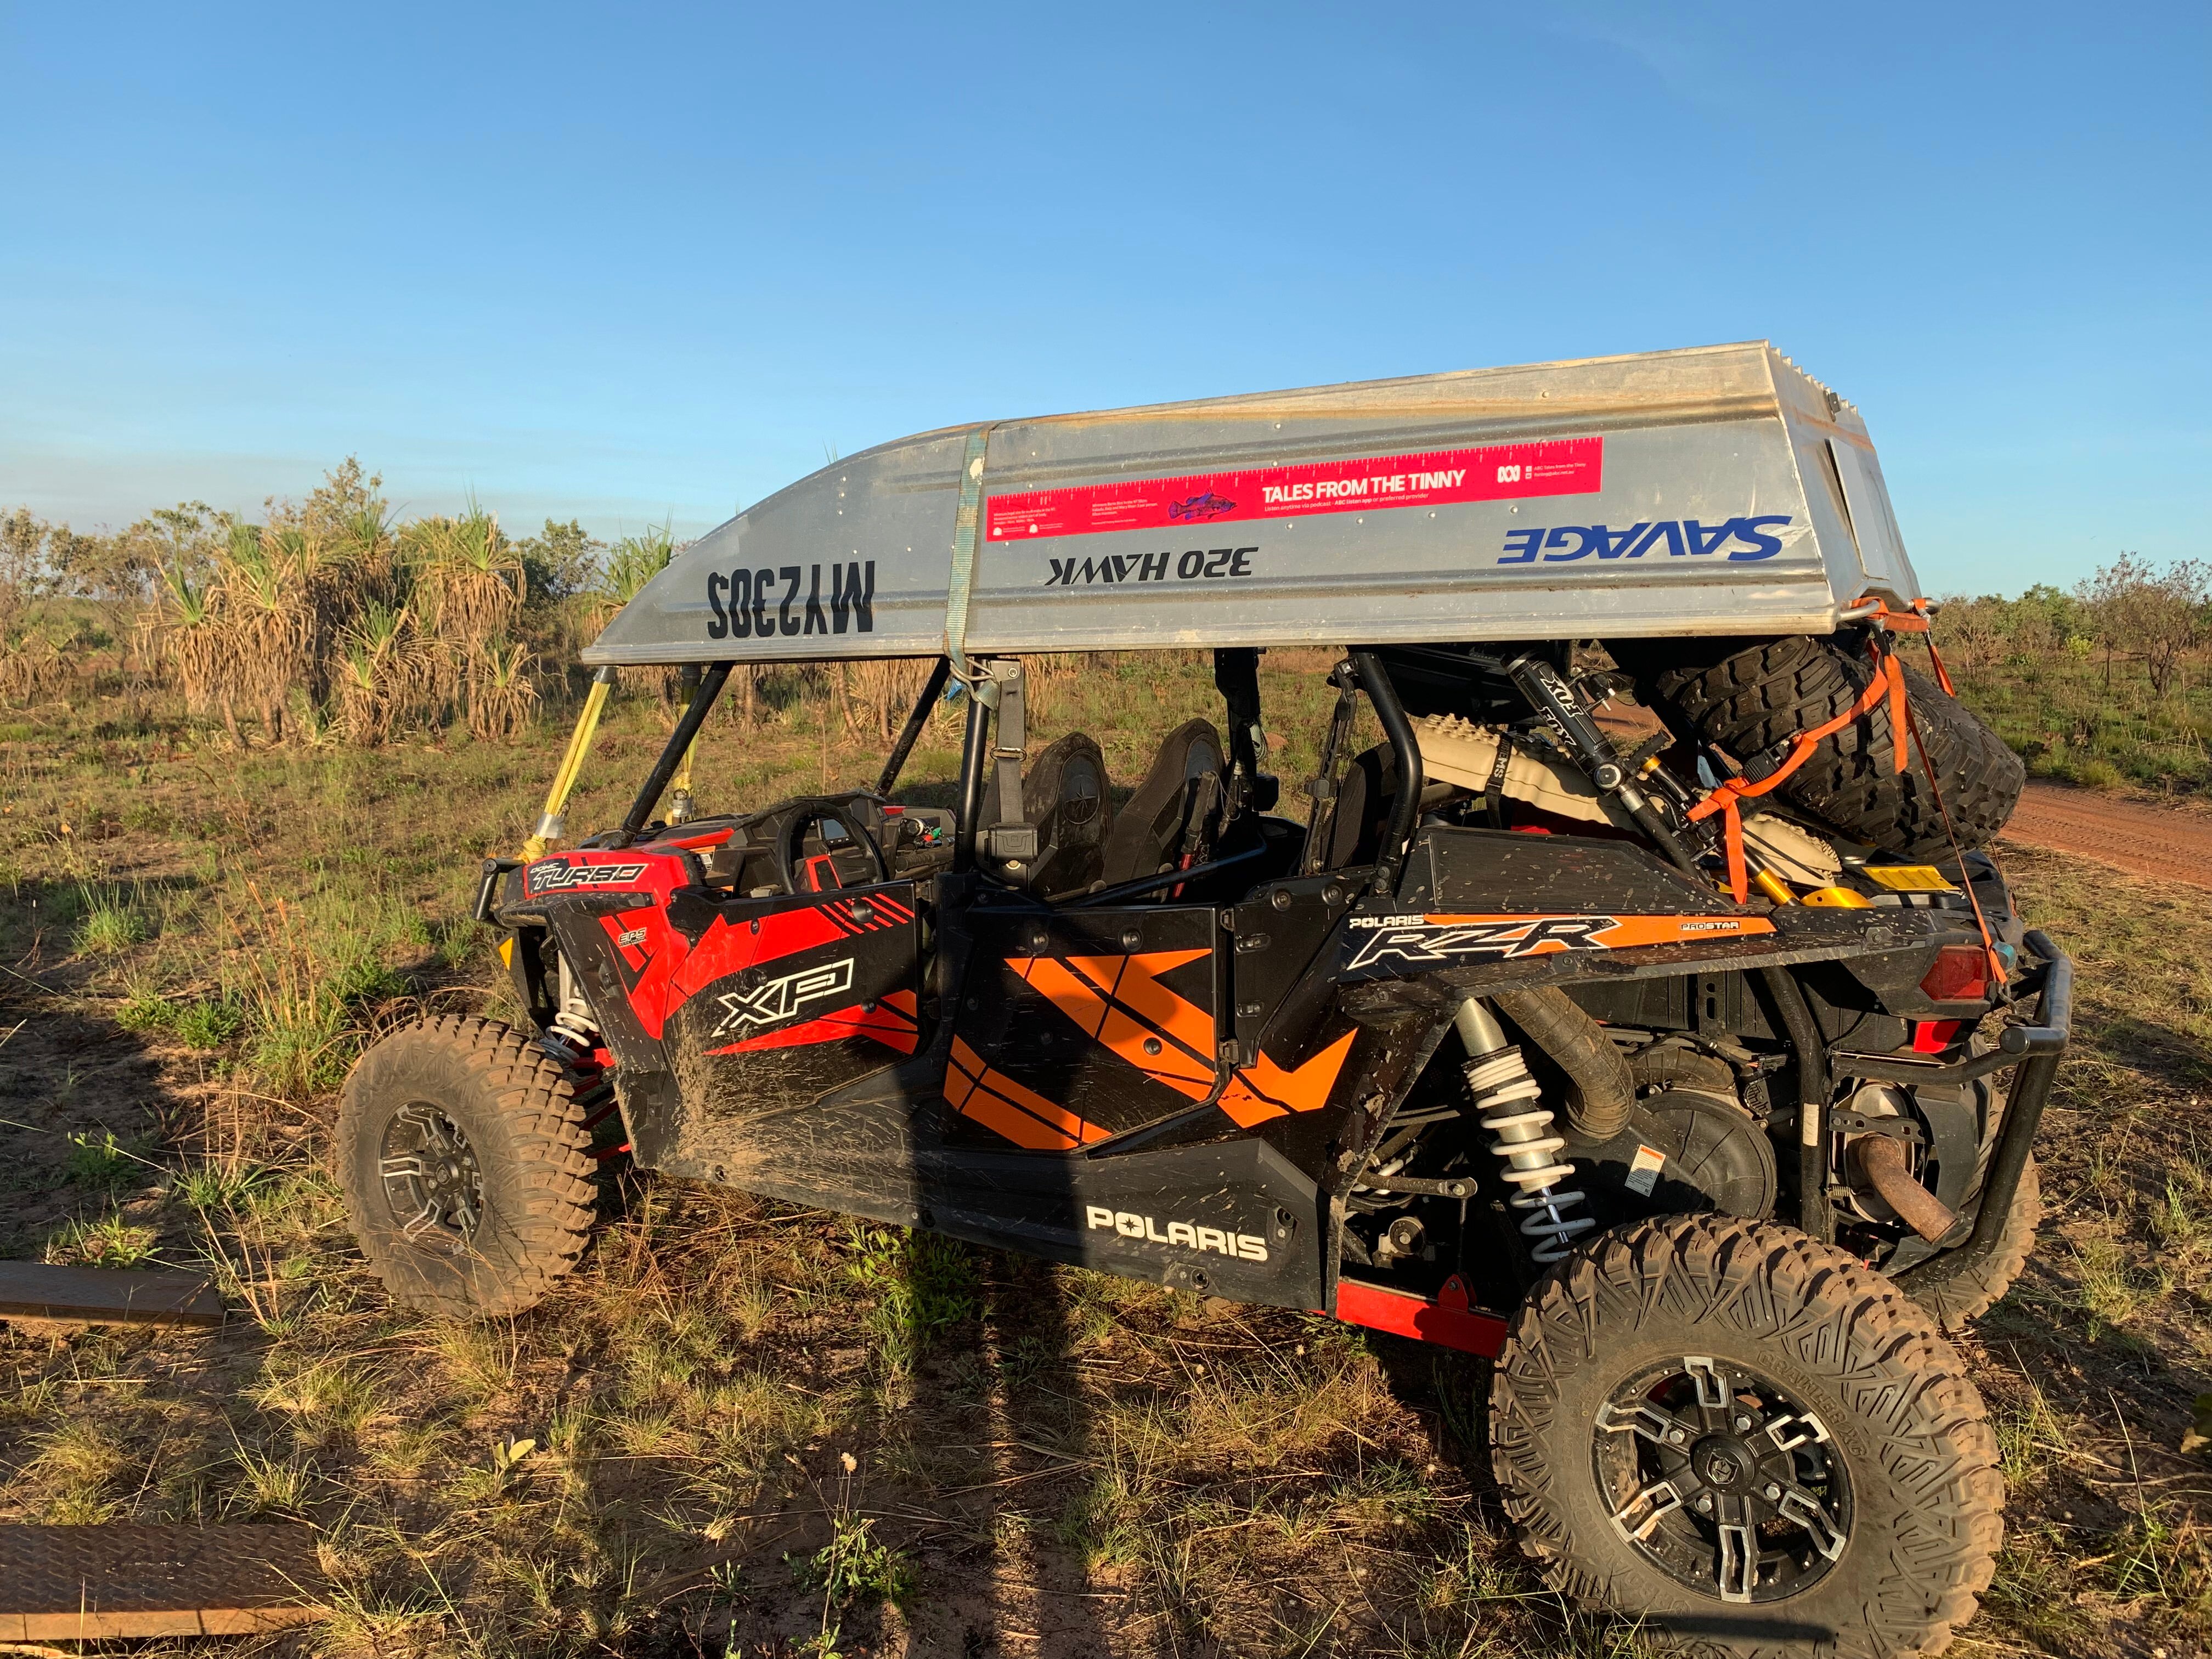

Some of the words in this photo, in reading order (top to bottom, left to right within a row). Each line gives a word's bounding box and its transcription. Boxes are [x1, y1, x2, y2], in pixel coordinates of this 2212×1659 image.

[1263, 484, 1314, 503] TALES
[1317, 478, 1368, 499] FROM
[1370, 475, 1406, 493] THE
[1408, 469, 1466, 491] TINNY
[1310, 501, 1331, 509] podcast
[1379, 494, 1405, 502] preferred
[1497, 515, 1793, 565] SAVAGE
[1045, 552, 1170, 586] HAWK
[1177, 547, 1259, 579] 320
[708, 561, 876, 639] MY230S
[1540, 672, 1584, 718] FOX
[530, 863, 560, 873] DOHC
[533, 864, 649, 890] TURBO
[619, 927, 647, 943] EPS
[1350, 915, 1425, 928] POLARIS
[1680, 922, 1740, 930] PROSTAR
[1347, 915, 1624, 970] RZR
[711, 958, 854, 1037] XP
[1086, 1205, 1268, 1262] POLARIS
